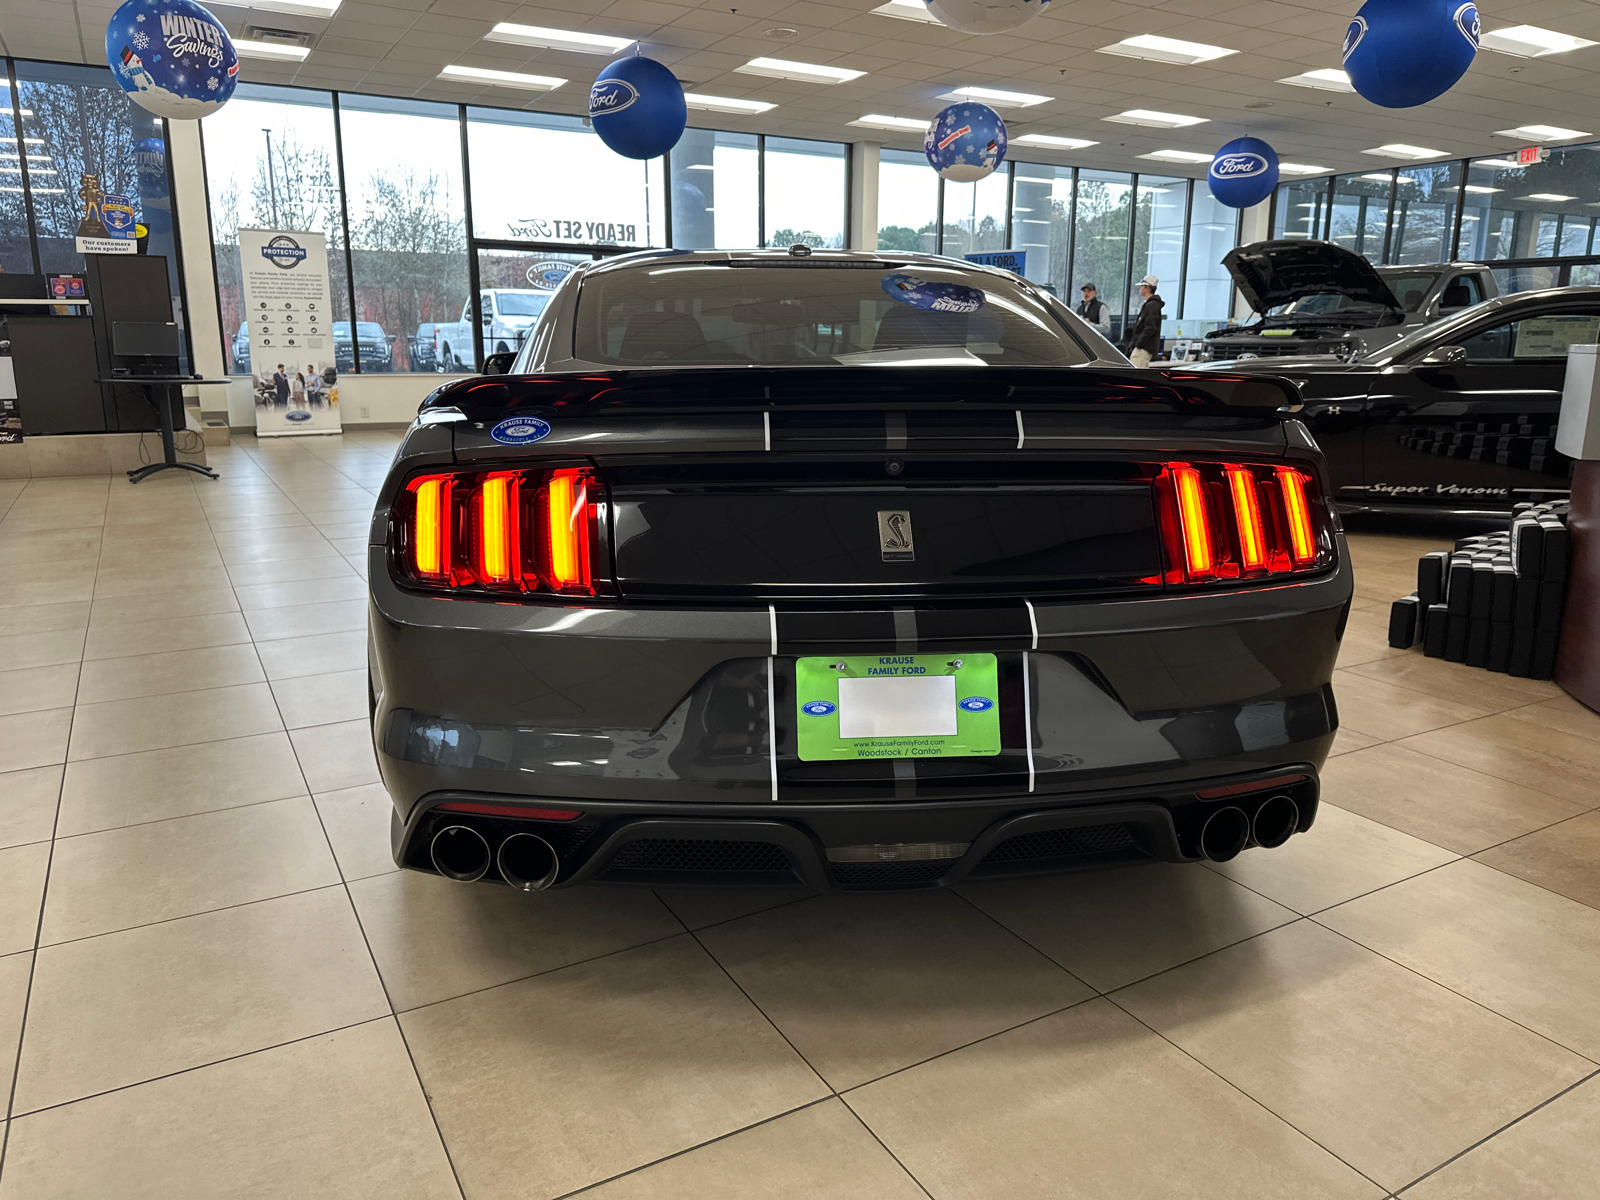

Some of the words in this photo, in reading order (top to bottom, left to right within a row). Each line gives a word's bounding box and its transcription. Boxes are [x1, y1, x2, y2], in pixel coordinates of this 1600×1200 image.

[160, 15, 224, 48] WINTER
[166, 33, 224, 68] Savings
[589, 86, 618, 110] Ford
[1520, 148, 1538, 162] EXIT
[1219, 158, 1255, 174] Ford
[992, 255, 1018, 267] FORD.
[500, 420, 522, 429] KRAUSE
[1369, 483, 1429, 496] Super
[1436, 484, 1507, 495] Venom
[879, 656, 914, 665] KRAUSE
[868, 668, 899, 676] FAMILY
[902, 666, 926, 675] FORD
[853, 739, 945, 748] www.KrauseFamilyFord.com
[858, 749, 902, 757] Woodstock
